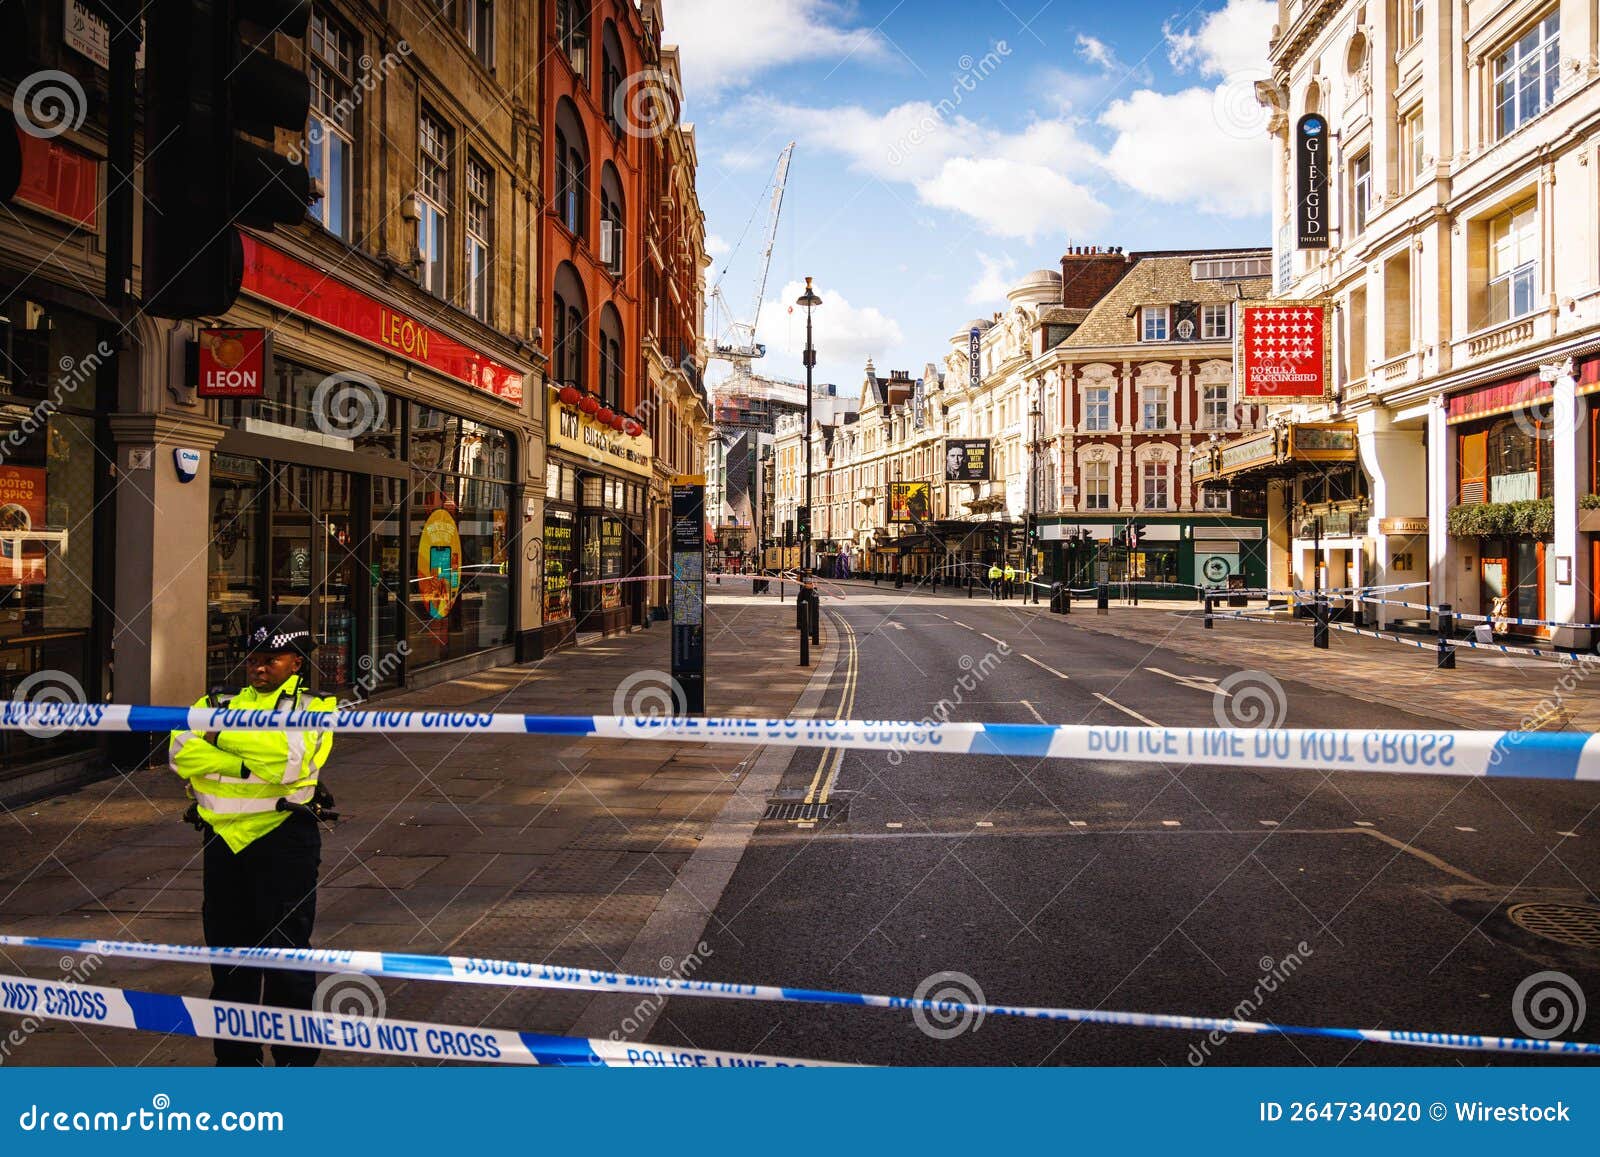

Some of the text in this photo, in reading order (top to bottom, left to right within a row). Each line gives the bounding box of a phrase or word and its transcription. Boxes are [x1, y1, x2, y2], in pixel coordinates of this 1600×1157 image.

[1306, 137, 1321, 234] GIELGUD
[380, 308, 429, 362] LEON
[207, 370, 257, 388] LEON
[971, 336, 980, 385] APOLLO
[1250, 366, 1297, 375] TO KILL A
[1250, 373, 1318, 382] MOCKINGBIRD
[916, 386, 924, 426] LYRIC
[0, 479, 35, 490] OOTED
[209, 707, 282, 728] POLICE
[2, 981, 109, 1021] NOT CROSS
[214, 1005, 502, 1059] POLICE LINE DO NOT CROSS
